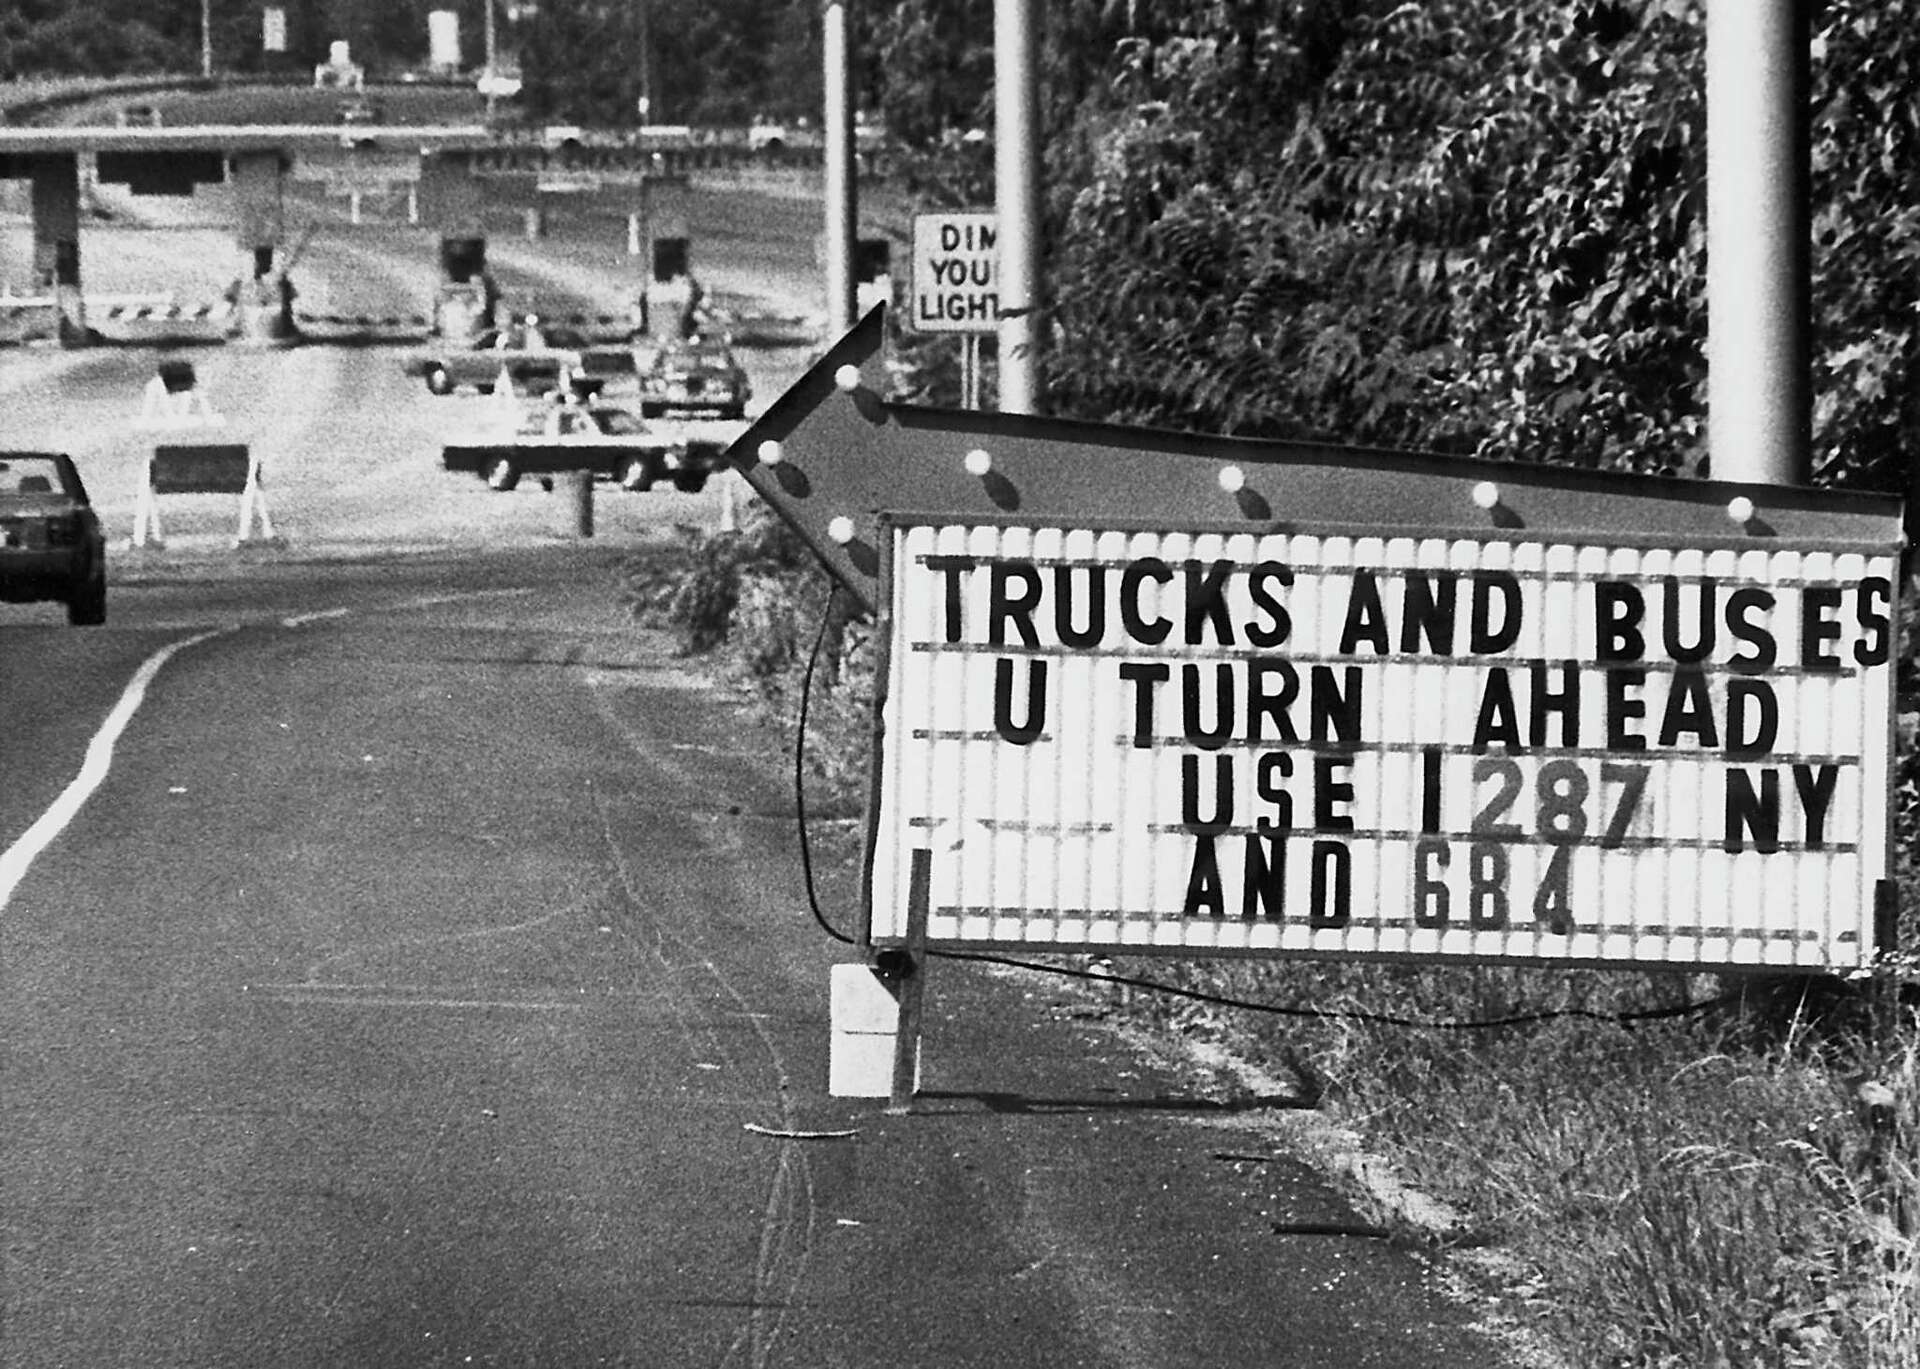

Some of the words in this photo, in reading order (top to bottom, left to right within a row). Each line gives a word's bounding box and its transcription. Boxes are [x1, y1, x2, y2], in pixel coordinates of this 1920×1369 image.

[930, 258, 1000, 286] YOU
[942, 224, 996, 251] DIM
[925, 555, 1294, 649] TRUCKS
[1339, 567, 1523, 655] AND
[1595, 575, 1891, 676] BUSES
[994, 658, 1047, 746] U
[1119, 657, 1362, 754] TURN
[1472, 658, 1779, 763] AHEAD
[1182, 751, 1355, 839] USE
[1423, 748, 1441, 834] I
[1471, 759, 1650, 849] 287
[1725, 764, 1839, 854] NY
[1183, 833, 1351, 930] AND
[1414, 838, 1575, 935] 684
